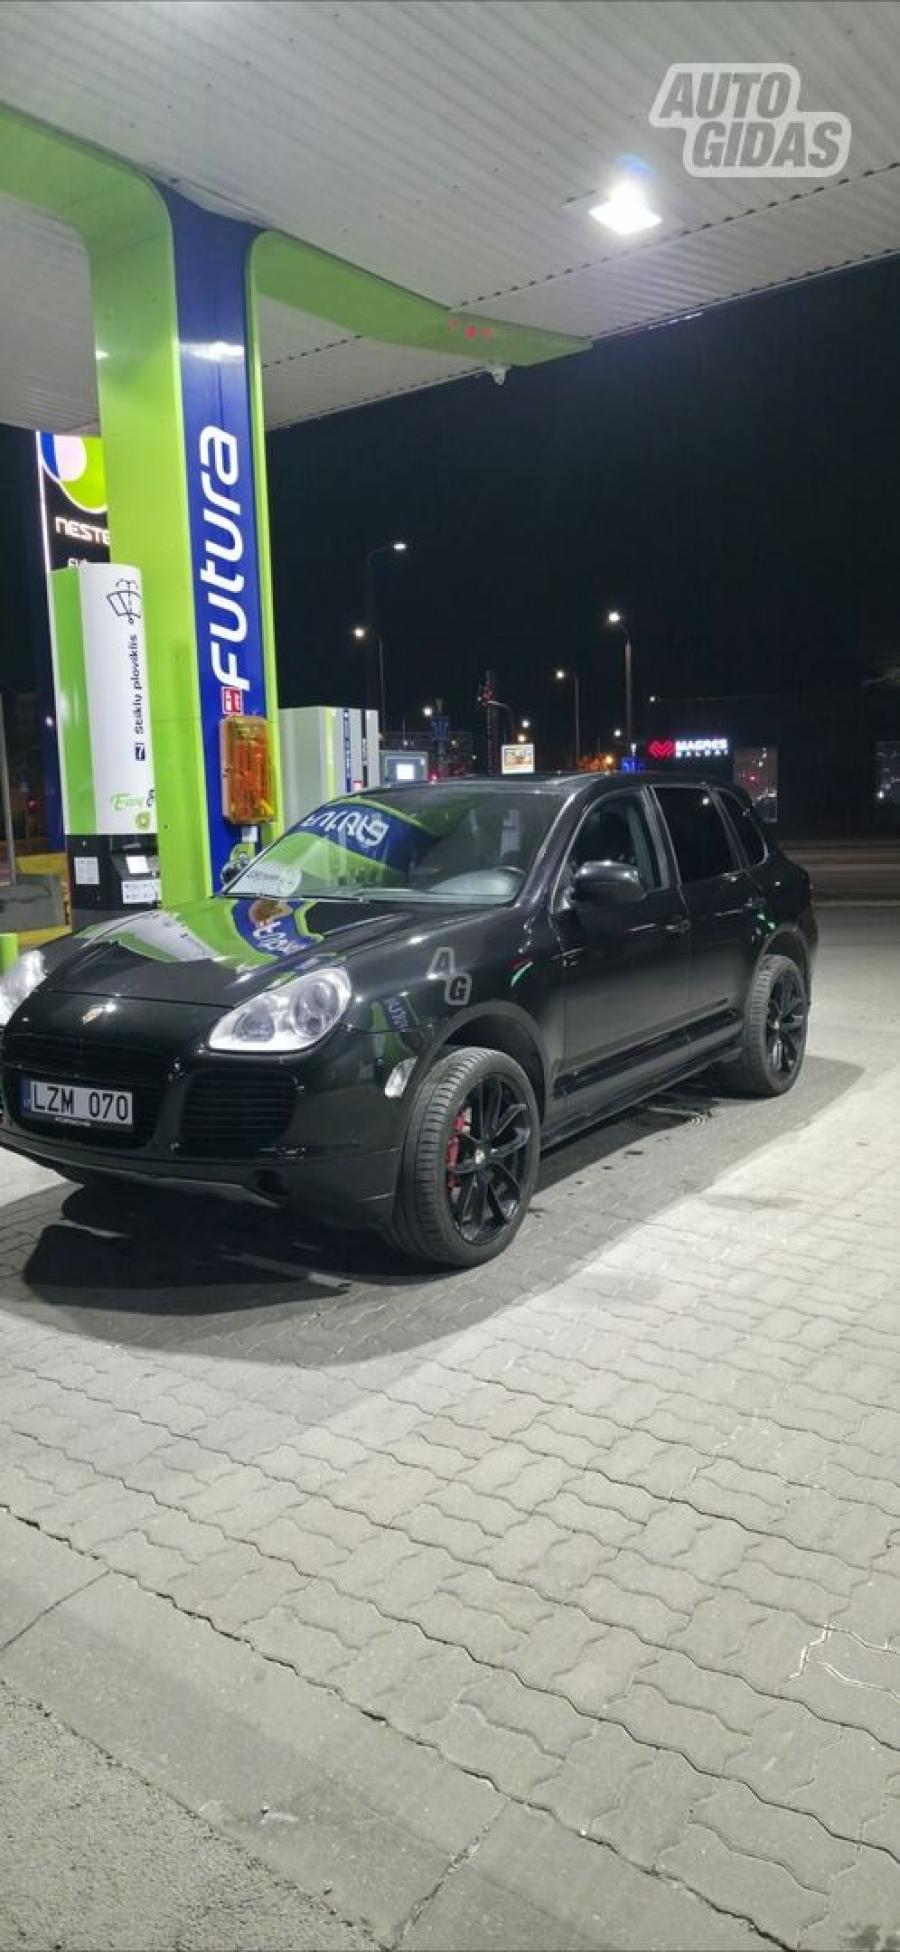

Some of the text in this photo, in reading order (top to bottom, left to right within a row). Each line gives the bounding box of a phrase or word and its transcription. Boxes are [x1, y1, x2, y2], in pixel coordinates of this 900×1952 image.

[200, 424, 250, 692] Futura
[33, 1083, 129, 1121] LZM 070
